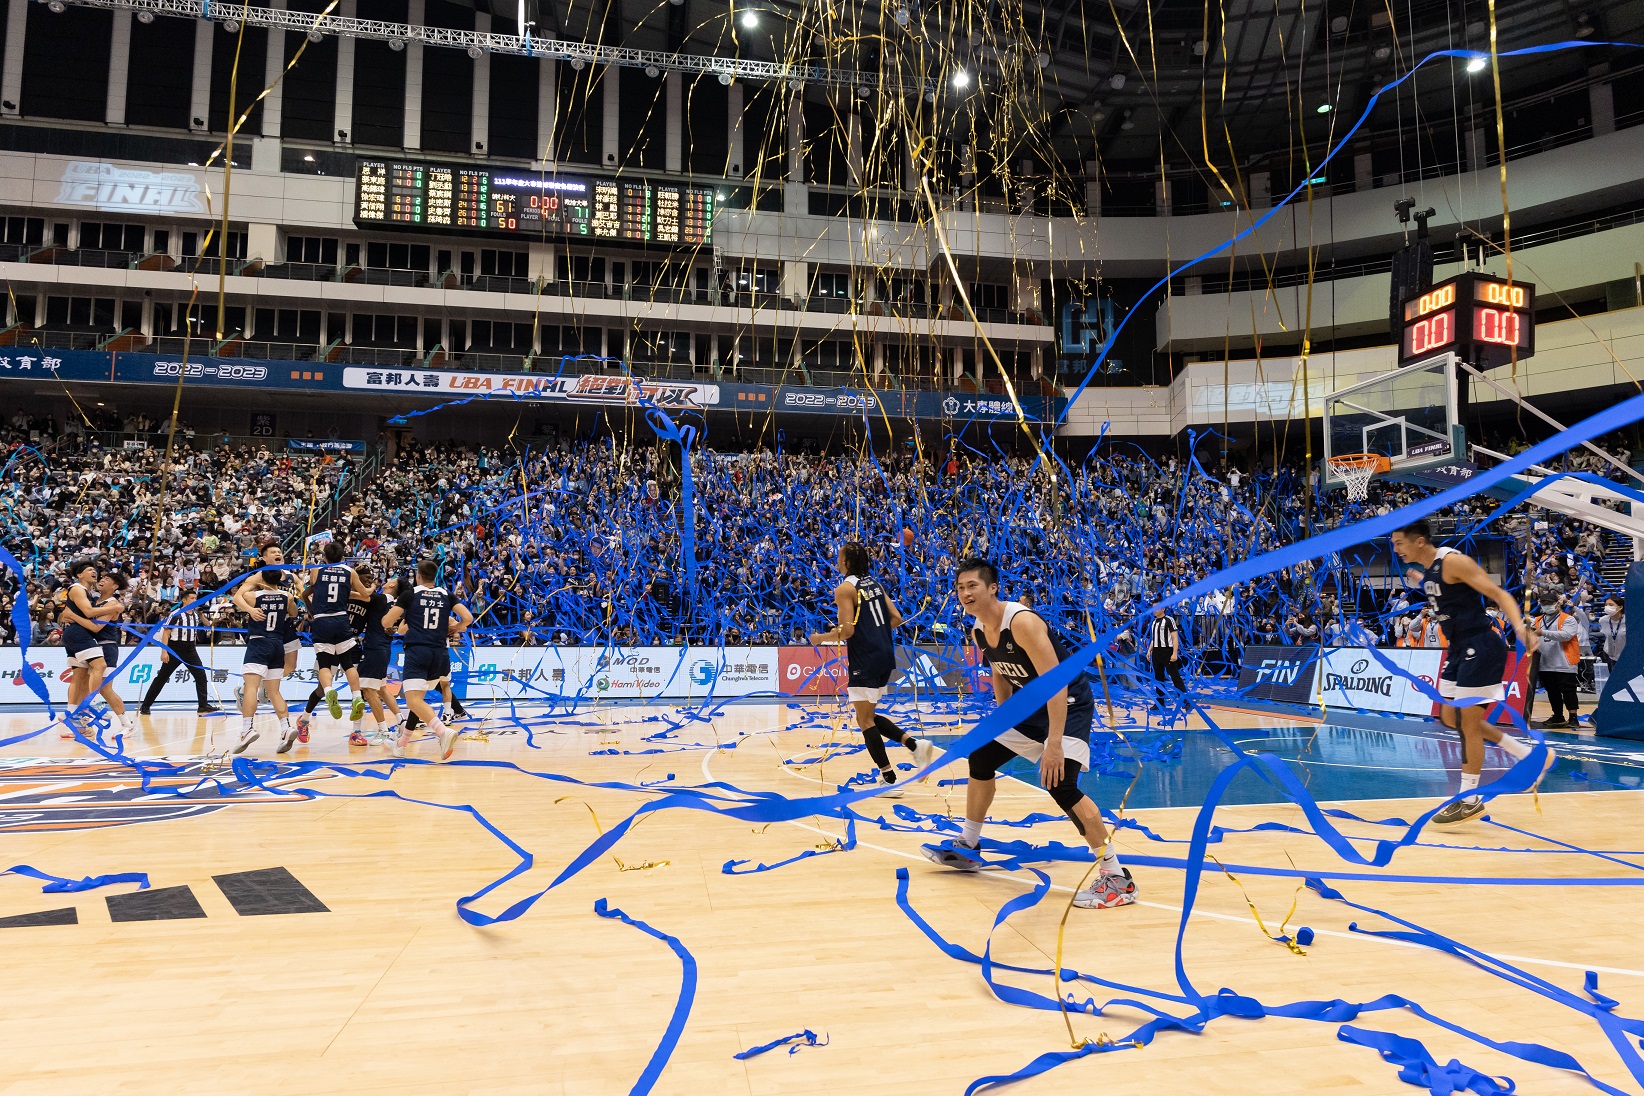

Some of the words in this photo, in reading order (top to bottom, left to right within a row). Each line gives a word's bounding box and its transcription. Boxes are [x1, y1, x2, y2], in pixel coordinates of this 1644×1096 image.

[68, 183, 191, 206] FINAL
[496, 201, 512, 213] 61
[575, 206, 588, 218] 71
[580, 224, 588, 235] 5
[1419, 285, 1452, 316] 0.00
[1488, 283, 1524, 308] 0.00
[1412, 312, 1448, 355] 0.0
[1481, 308, 1520, 346] 0.0
[153, 362, 268, 380] 2022-2023
[1057, 359, 1123, 375] 富邦壽
[366, 372, 440, 388] 富邦人壽
[448, 375, 492, 390] UBA
[253, 427, 272, 436] 2D
[327, 583, 339, 603] 9
[346, 603, 367, 617] CCU
[423, 607, 440, 630] 13
[868, 599, 886, 627] 11
[266, 611, 278, 632] 0
[612, 657, 650, 666] MOD
[722, 663, 769, 675] 中華電信
[1, 669, 55, 679] Hiet
[501, 668, 566, 683] 富邦人壽
[1323, 672, 1394, 698] SPALDING
